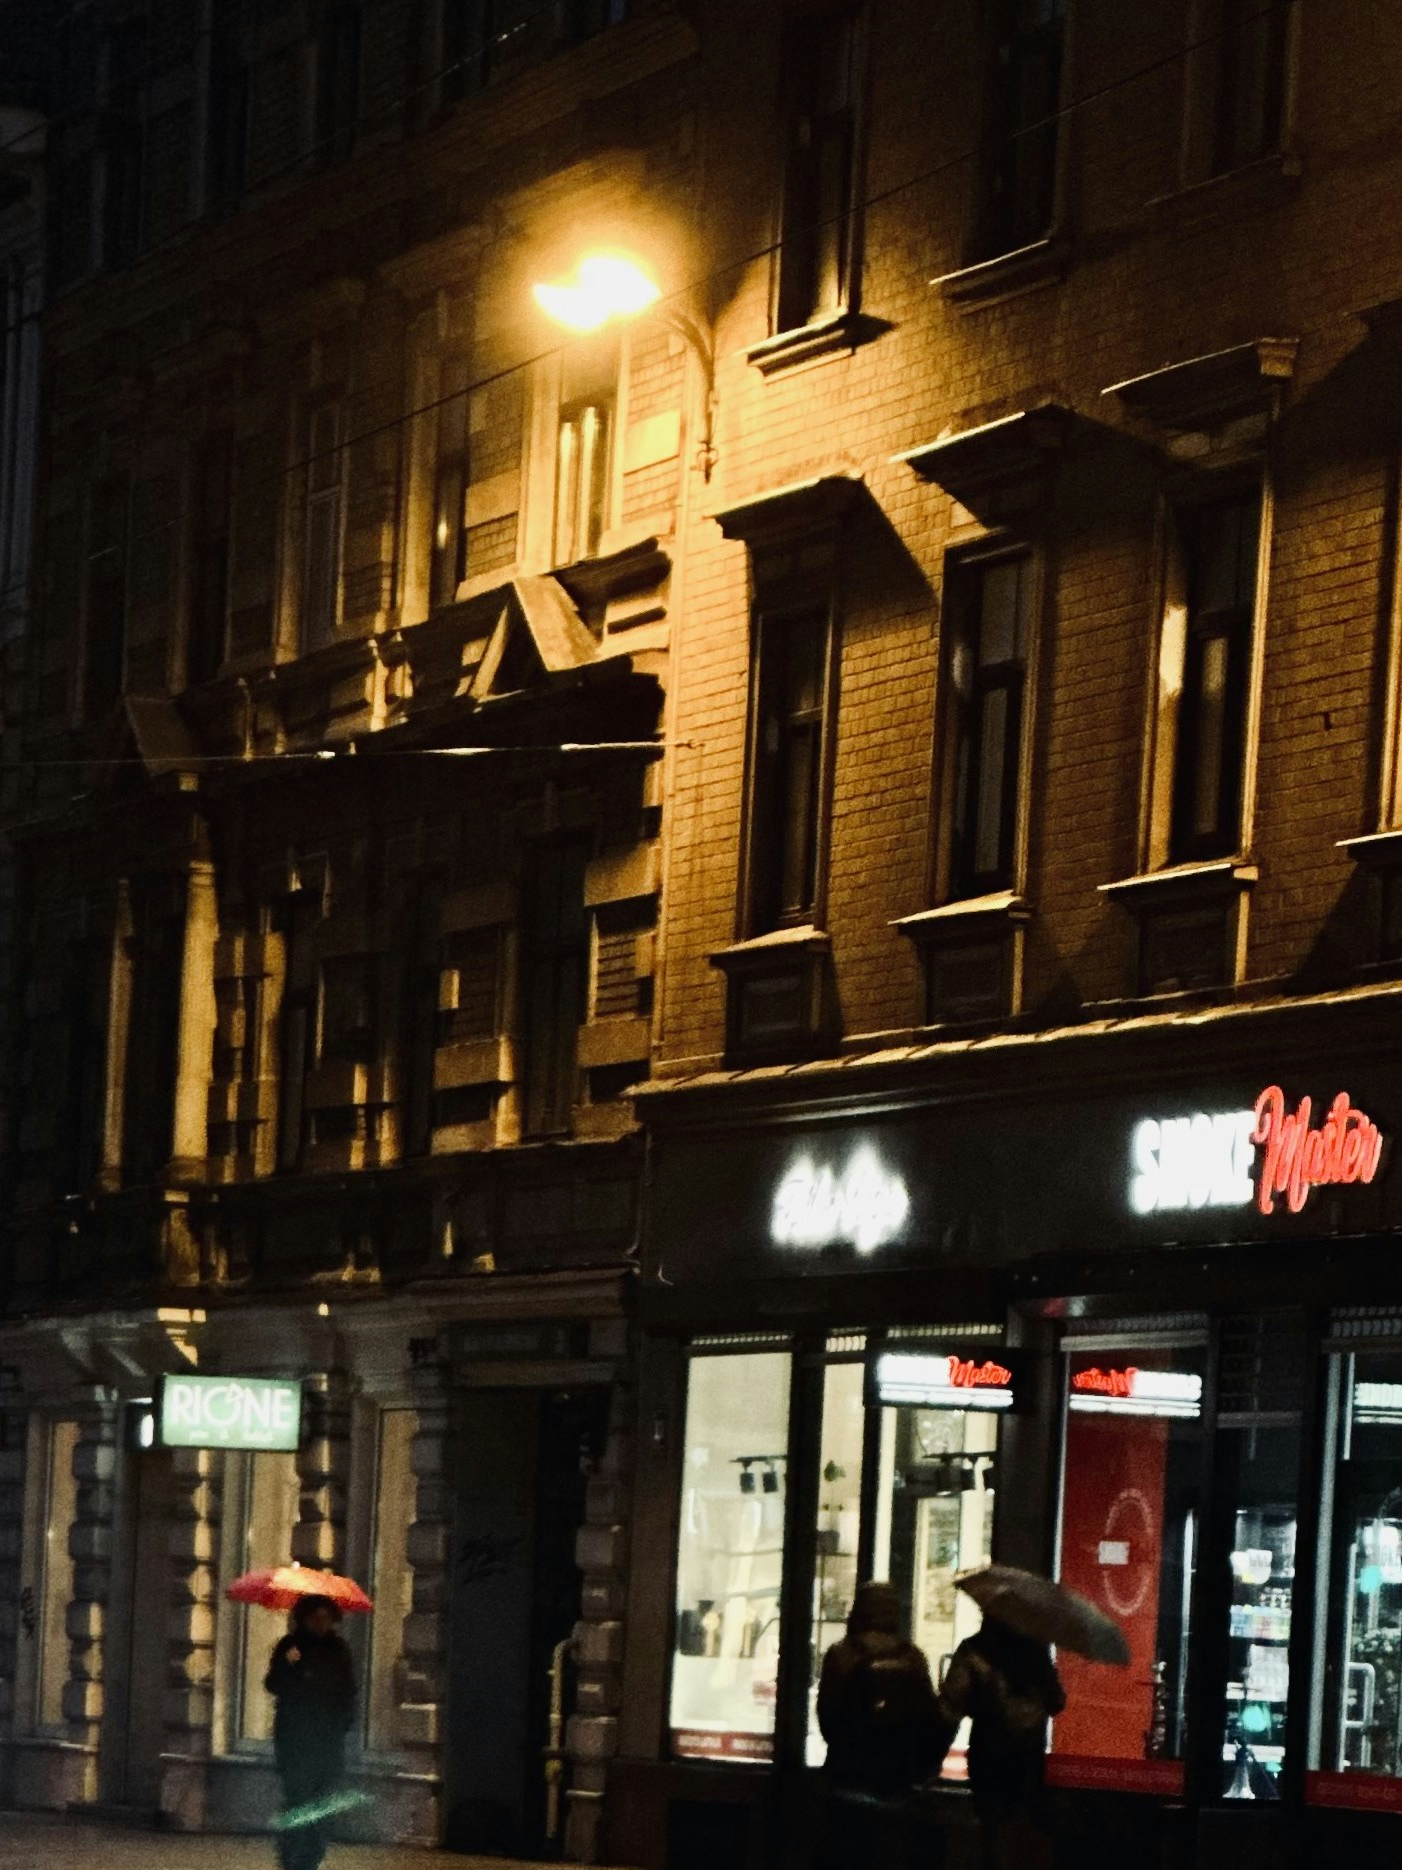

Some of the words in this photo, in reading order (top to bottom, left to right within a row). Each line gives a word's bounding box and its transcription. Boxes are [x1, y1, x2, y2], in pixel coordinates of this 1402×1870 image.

[1250, 1086, 1383, 1215] Master
[947, 1355, 1012, 1387] Master
[171, 1383, 293, 1430] RIONE
